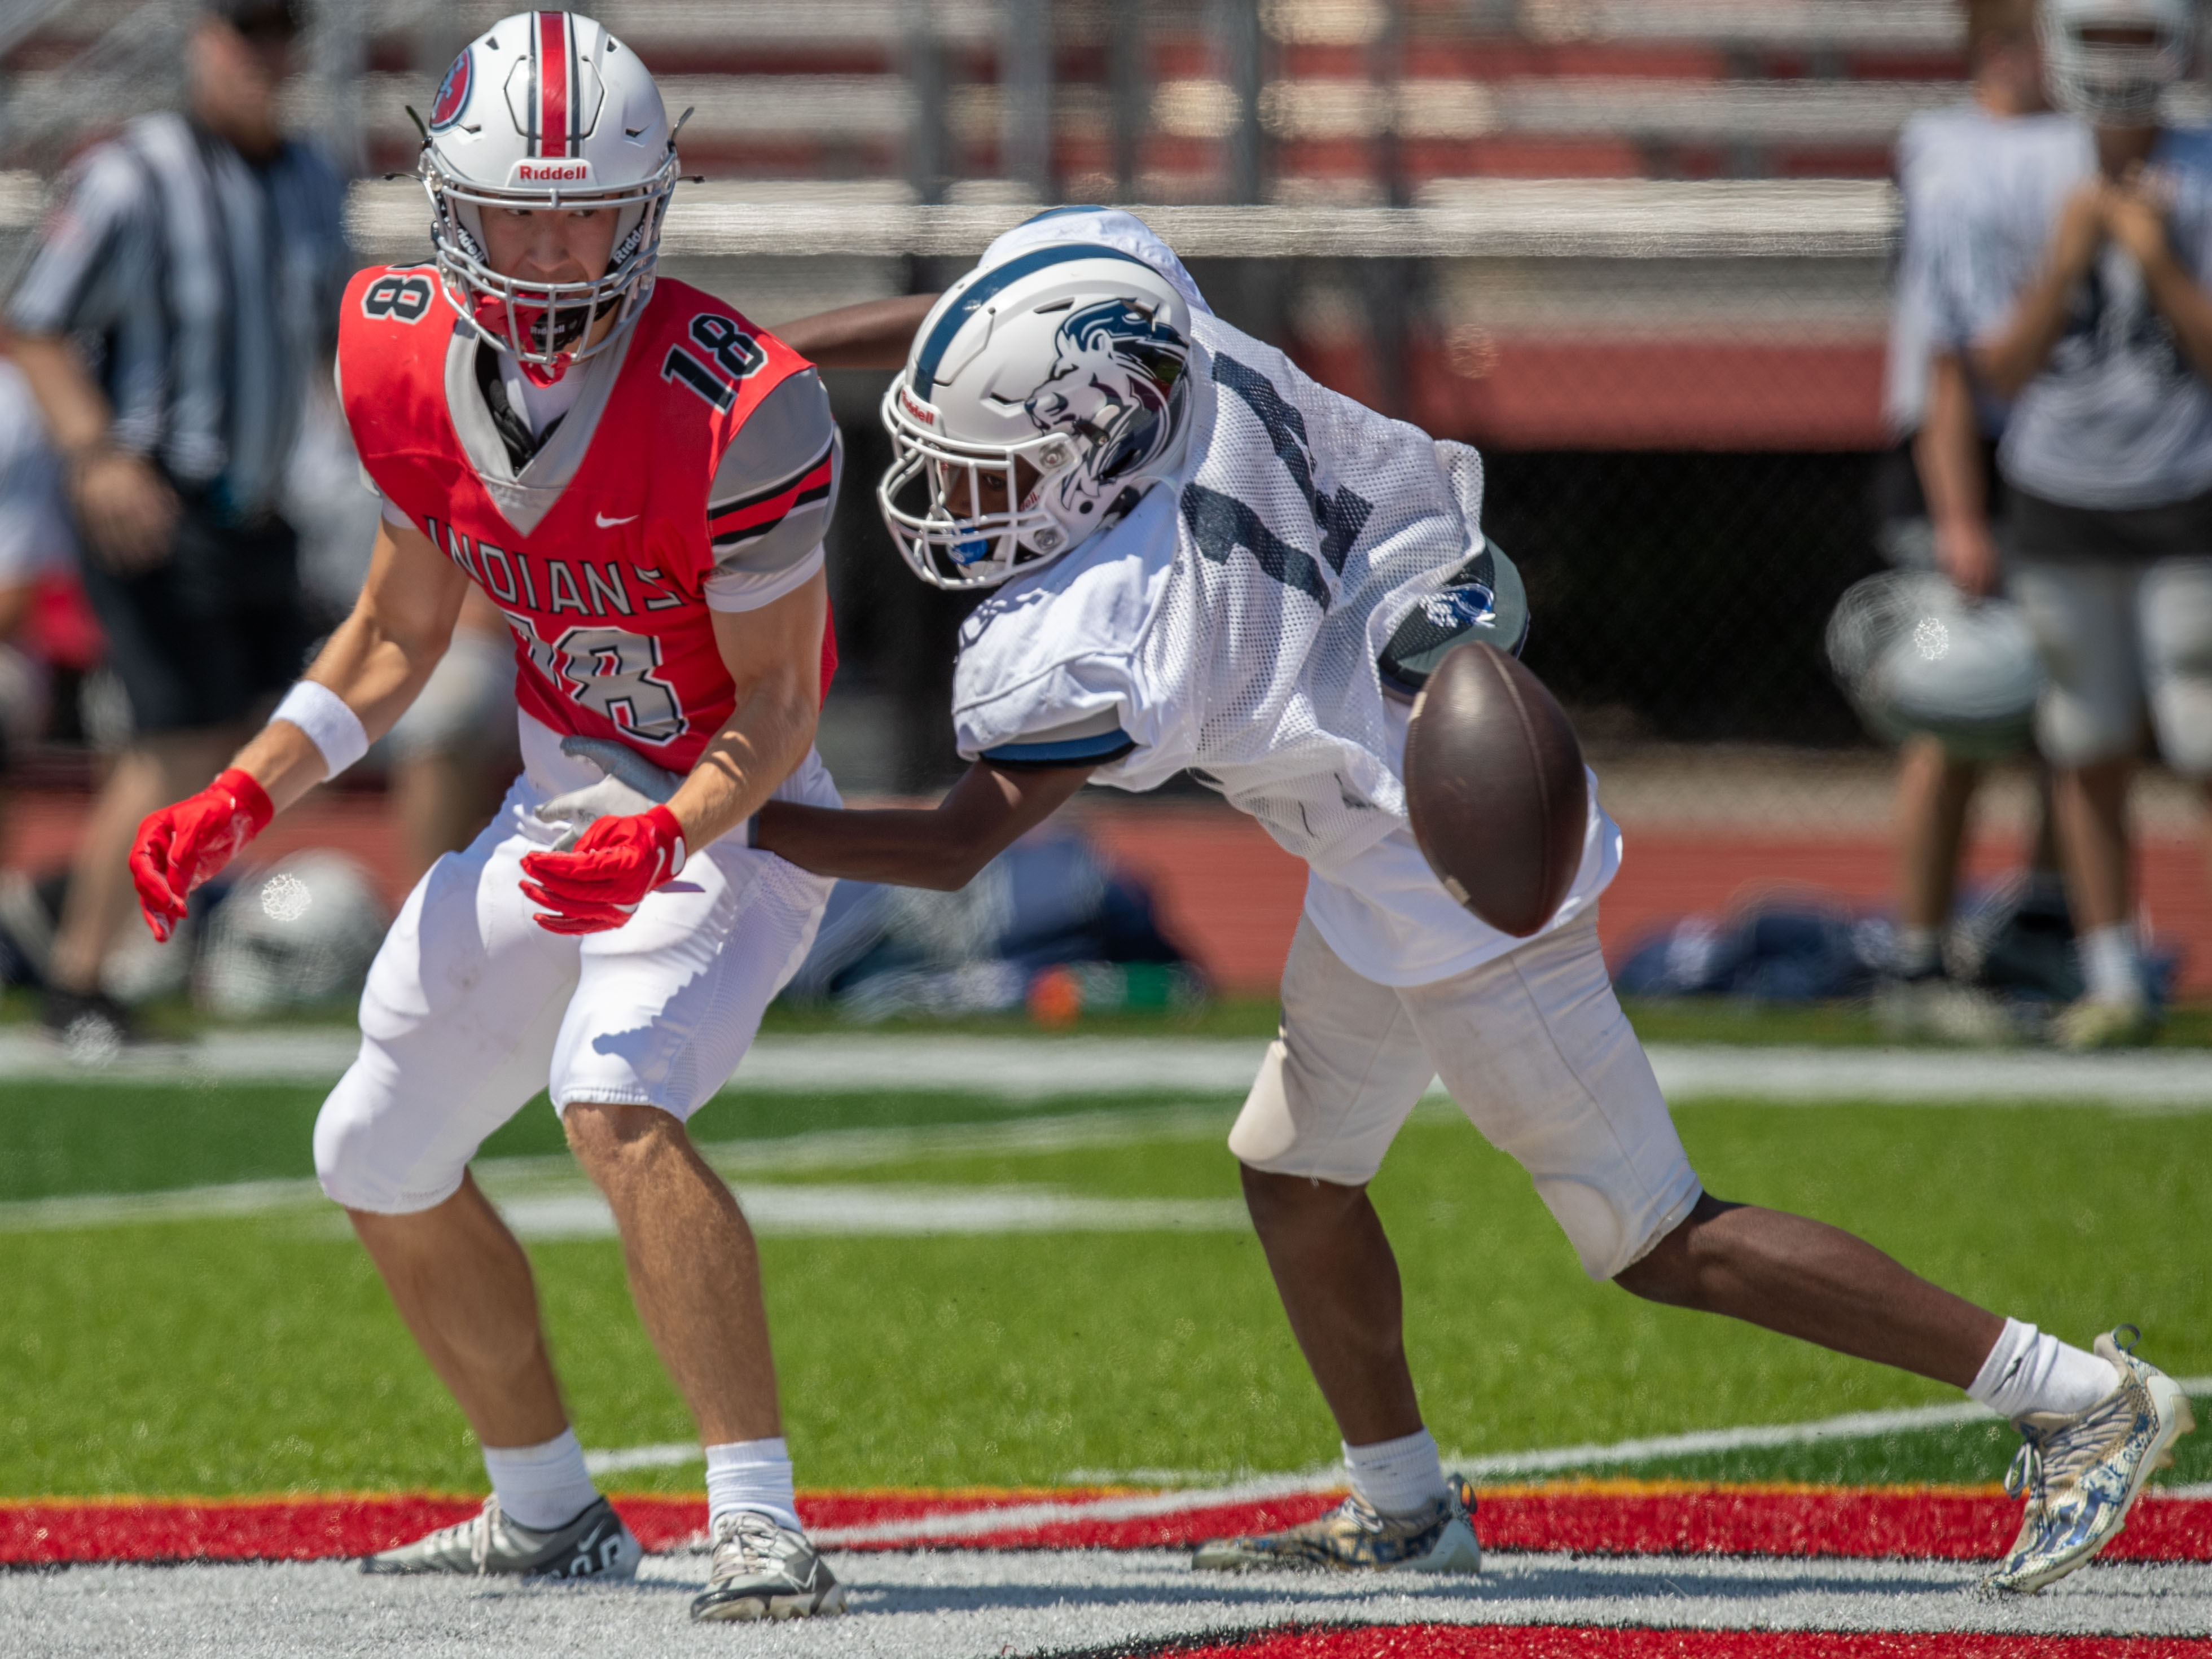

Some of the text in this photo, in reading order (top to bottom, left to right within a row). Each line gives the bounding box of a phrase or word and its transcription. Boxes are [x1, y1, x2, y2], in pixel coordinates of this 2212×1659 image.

[520, 165, 586, 179] Riddell
[660, 313, 768, 416] 18
[423, 515, 688, 616] INDIANS
[502, 609, 690, 747] 18
